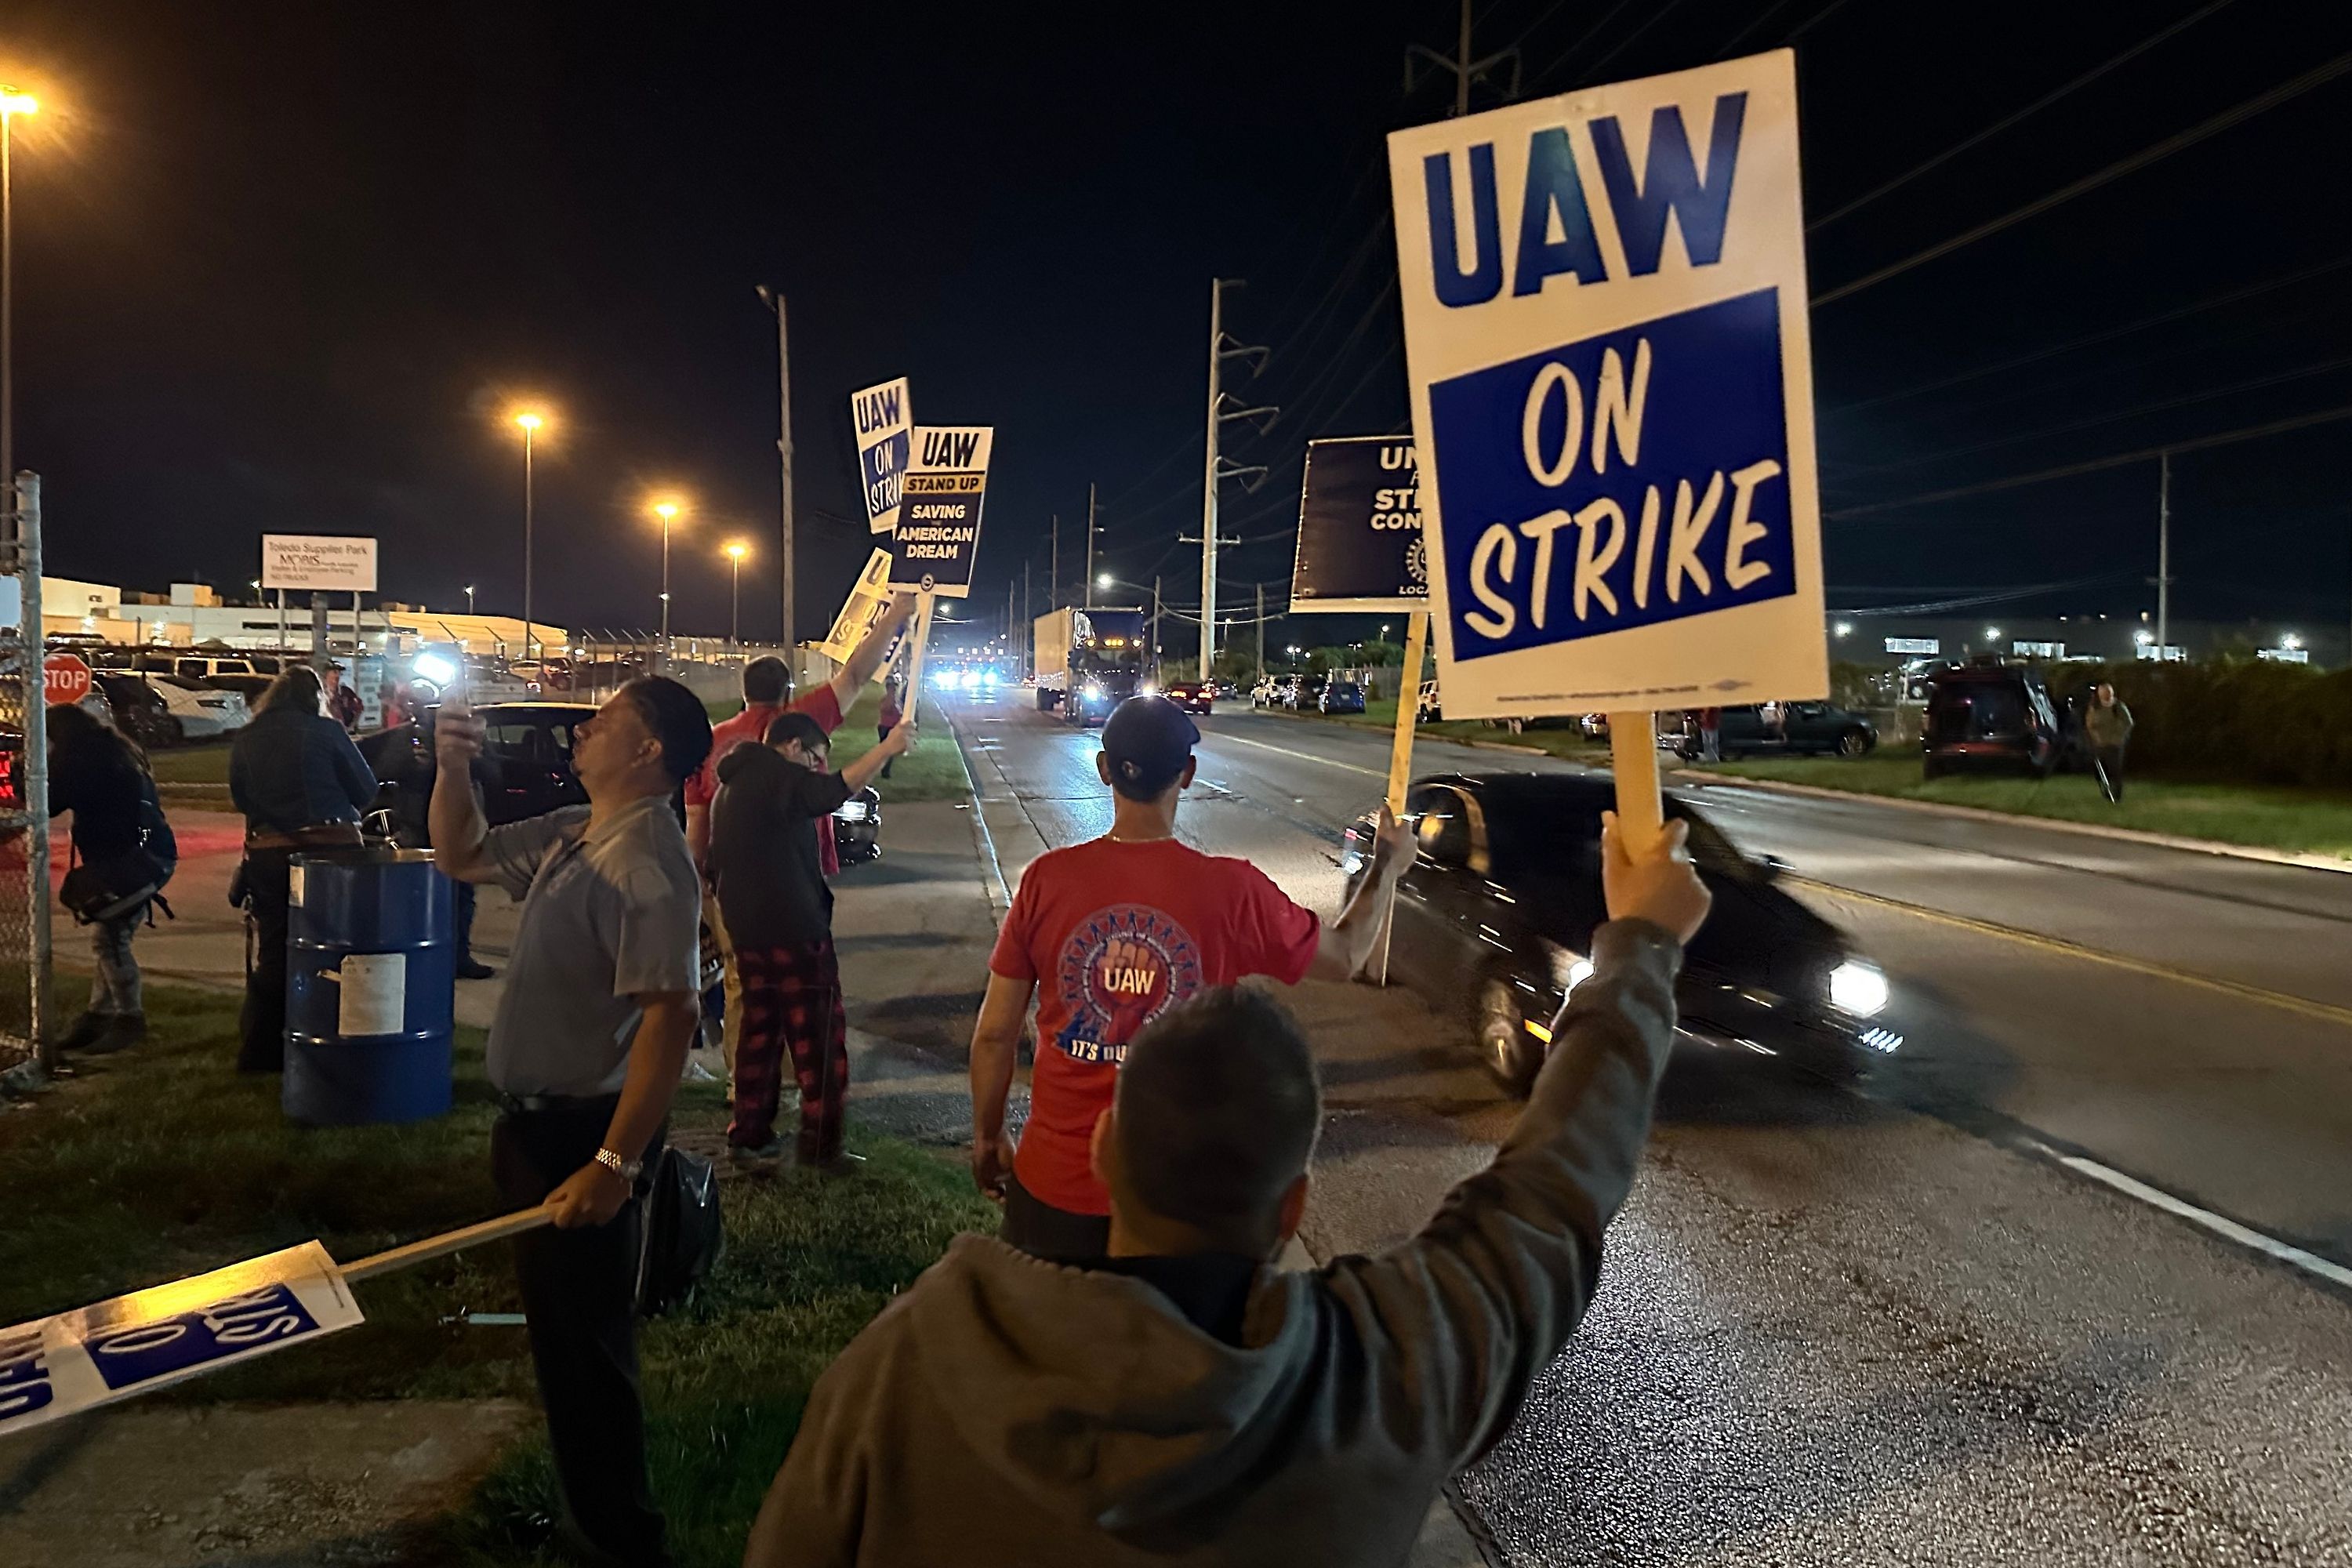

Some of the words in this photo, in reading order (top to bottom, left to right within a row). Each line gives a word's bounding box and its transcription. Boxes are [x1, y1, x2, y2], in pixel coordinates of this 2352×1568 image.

[1425, 91, 1748, 307] UAW
[857, 386, 900, 434] UAW
[1522, 338, 1652, 487] ON
[875, 440, 893, 475] ON
[922, 432, 979, 467] UAW
[908, 477, 955, 490] STAND
[959, 477, 978, 489] UP
[911, 505, 965, 519] SAVING
[897, 527, 973, 542] AMERICAN
[1465, 459, 1780, 638] STRIKE
[346, 544, 368, 555] Park
[906, 544, 958, 558] DREAM
[1104, 967, 1155, 995] UAW
[1071, 1039, 1098, 1061] IT'S
